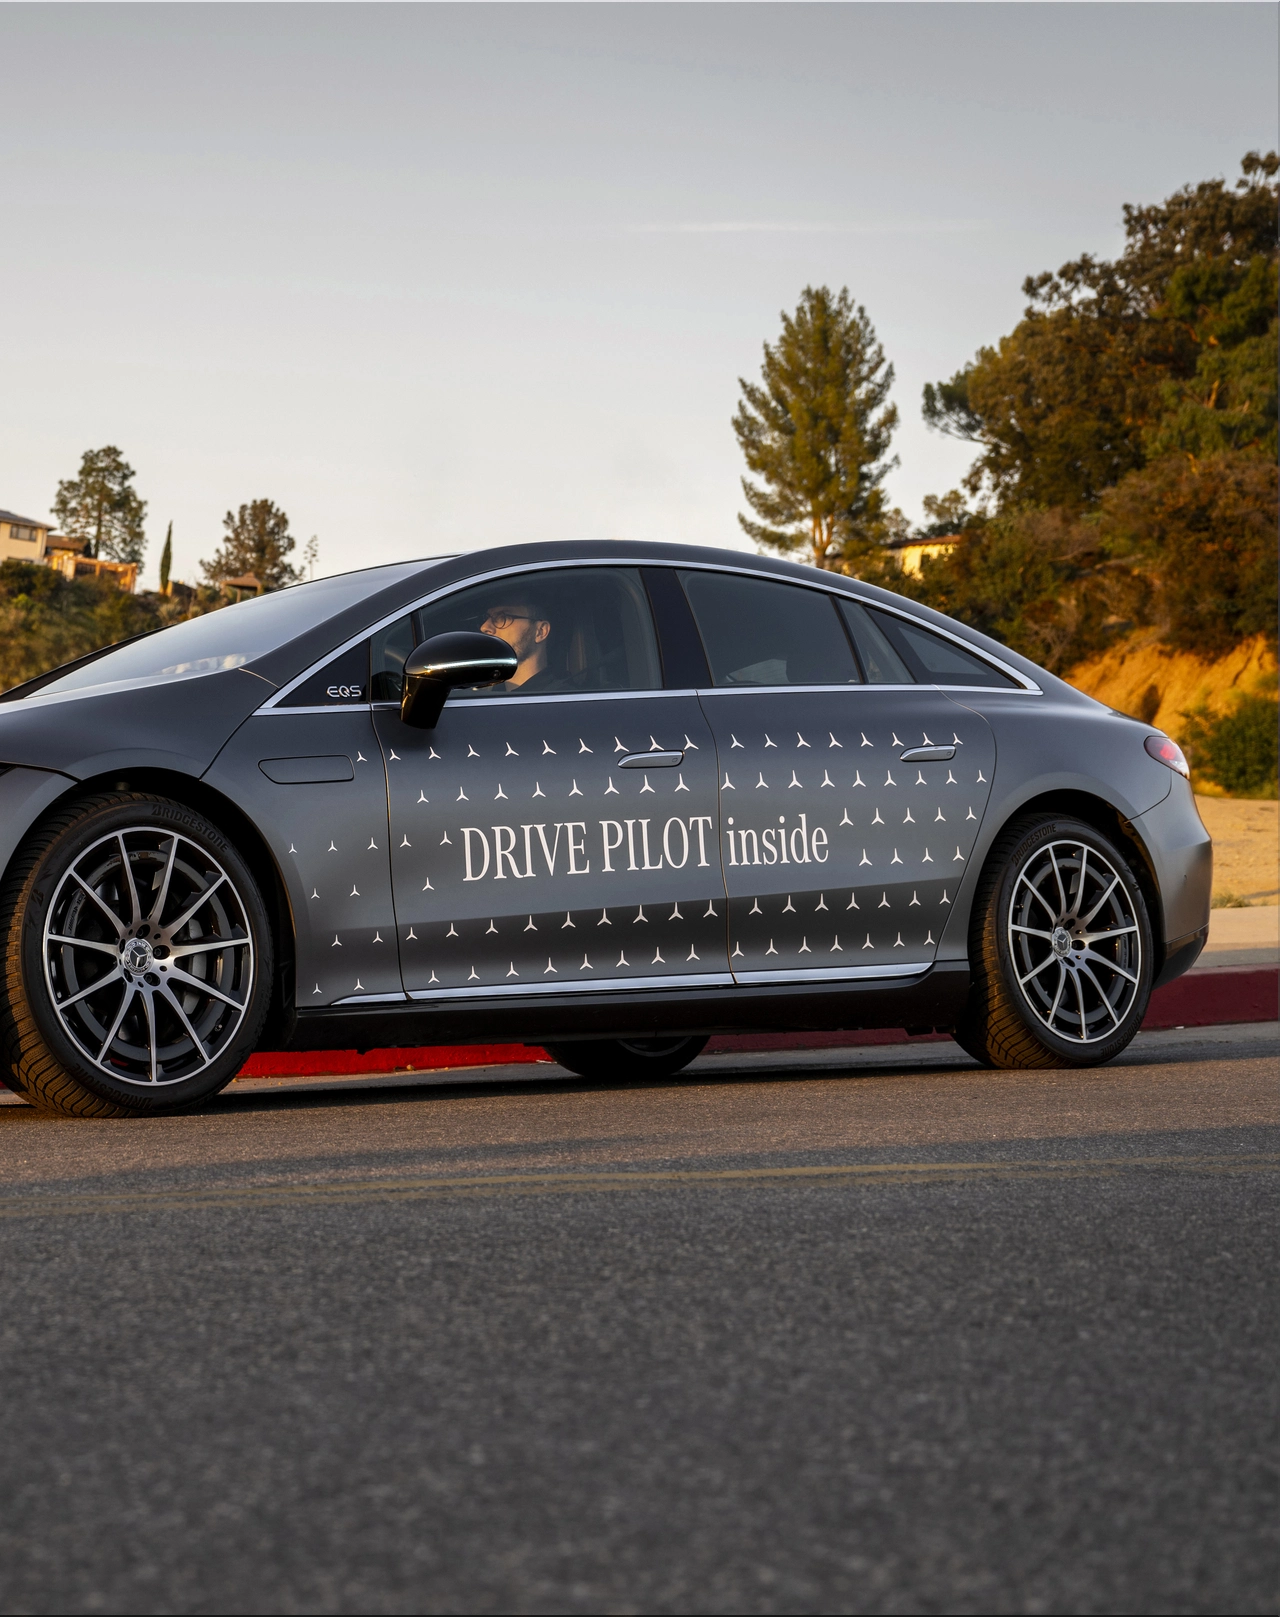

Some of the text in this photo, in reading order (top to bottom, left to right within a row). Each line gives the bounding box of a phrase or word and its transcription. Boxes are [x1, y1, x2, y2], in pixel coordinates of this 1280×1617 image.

[326, 685, 362, 698] EQS
[151, 804, 229, 853] BRIDGESTONE
[460, 813, 829, 881] DRIVE PILOT inside
[1011, 823, 1057, 867] BRIDGESTONE
